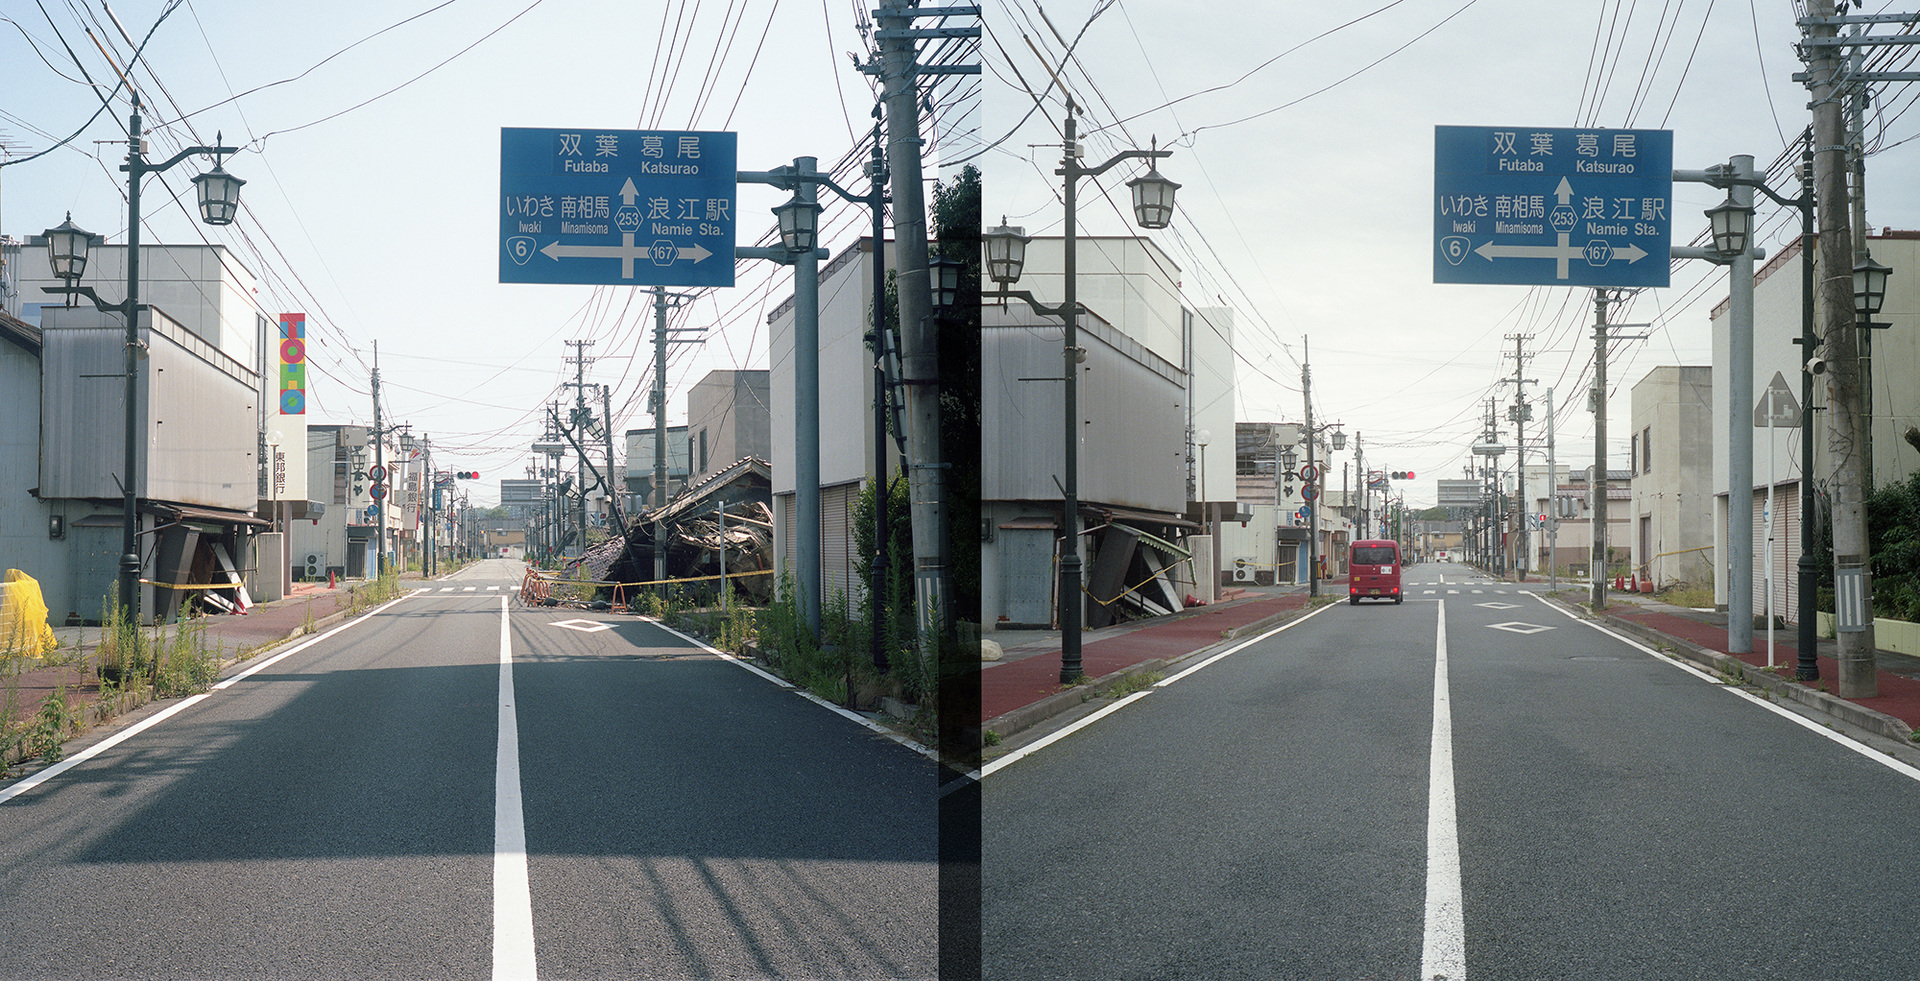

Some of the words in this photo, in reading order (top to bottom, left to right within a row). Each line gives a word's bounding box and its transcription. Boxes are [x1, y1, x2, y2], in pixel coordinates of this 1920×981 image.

[558, 133, 618, 158] 双葉
[640, 135, 701, 159] 葛尾
[1492, 131, 1553, 156] 双葉
[1575, 133, 1637, 158] 葛尾
[565, 160, 609, 173] Futaba
[641, 161, 699, 174] Katsurao
[1499, 158, 1544, 172] Futaba
[1576, 159, 1635, 174] Katsurao
[506, 195, 554, 217] いわき
[561, 195, 610, 219] 南相馬
[647, 196, 730, 221] 浪江駅
[1440, 194, 1489, 217] いわき
[1495, 194, 1545, 219] 南相馬
[1581, 196, 1666, 221] 浪江駅
[618, 212, 639, 225] 253
[1453, 220, 1476, 233] Iwaki
[1495, 221, 1544, 234] Minamisoma
[1553, 212, 1574, 225] 253
[519, 221, 542, 233] Iwaki
[561, 221, 609, 234] Minamisoma
[652, 222, 693, 236] Namie
[699, 222, 724, 236] Sta.
[1586, 222, 1628, 236] Namie
[1634, 222, 1660, 236] Sta.
[515, 240, 527, 257] 6
[652, 246, 672, 259] 167
[1449, 240, 1461, 257] 6
[1587, 246, 1607, 259] 167
[280, 313, 305, 415] TOHO
[275, 452, 286, 494] 東邦銀行
[406, 472, 418, 514] 福島銀行
